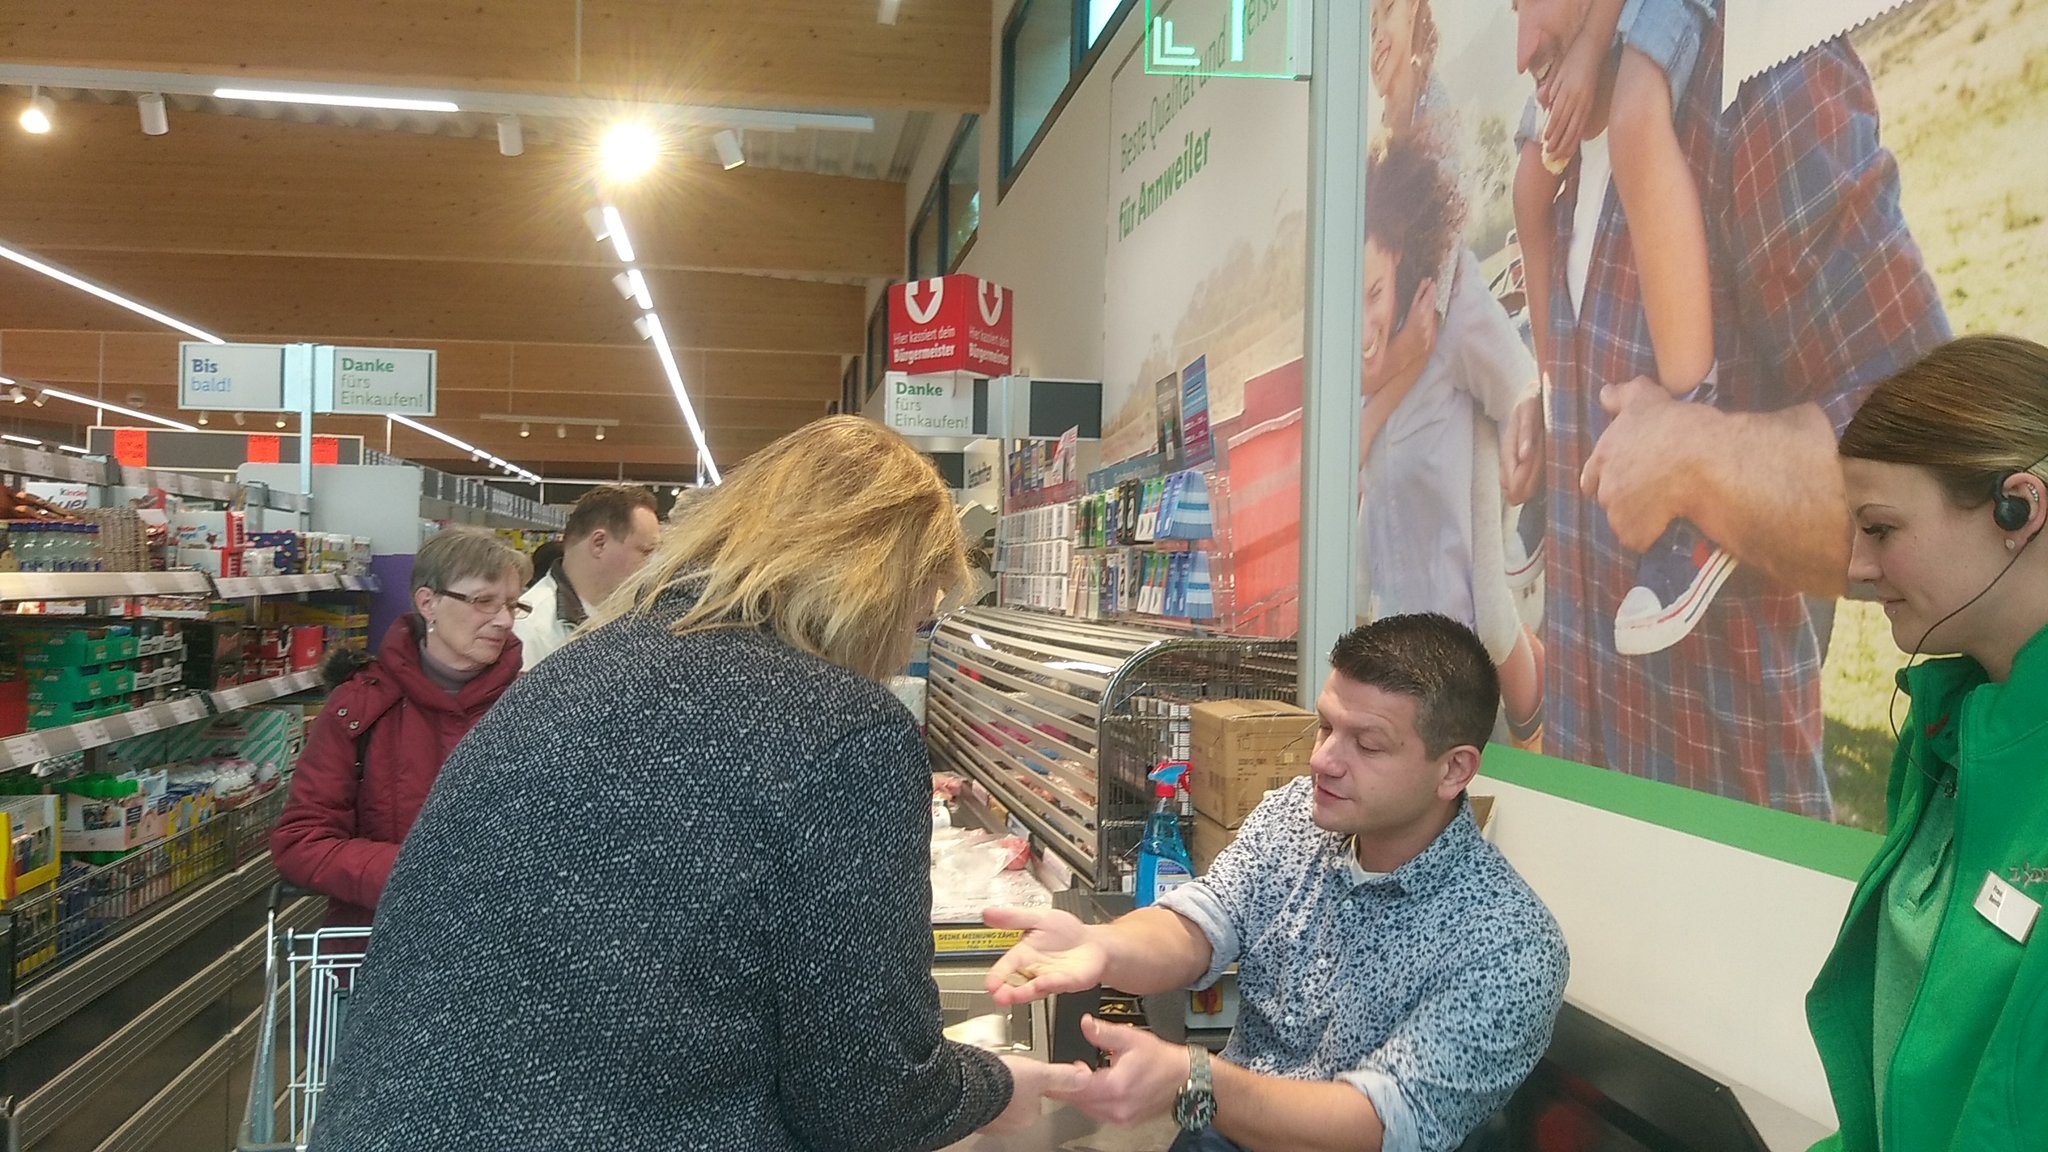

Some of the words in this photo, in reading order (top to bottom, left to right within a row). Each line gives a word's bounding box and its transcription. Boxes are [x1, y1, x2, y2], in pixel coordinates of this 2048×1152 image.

[1120, 119, 1147, 174] Beste
[1150, 62, 1195, 151] Qualität
[1200, 13, 1227, 89] und
[1118, 195, 1137, 243] für
[1136, 126, 1212, 226] Annweiler
[893, 331, 909, 346] Hier
[909, 328, 937, 343] kassiert
[937, 324, 956, 340] dein
[893, 342, 956, 365] Bürgermeister
[968, 342, 1010, 366] Bürgermeister
[191, 358, 218, 374] Bis
[341, 357, 395, 373] Danke
[190, 376, 232, 393] bald!
[341, 374, 371, 389] fürs
[895, 381, 944, 397] Danke
[341, 390, 424, 408] Einkaufen!
[895, 397, 922, 412] fürs
[895, 413, 969, 430] Einkaufen!
[938, 933, 960, 941] DEINE
[962, 931, 996, 940] MEINUNG
